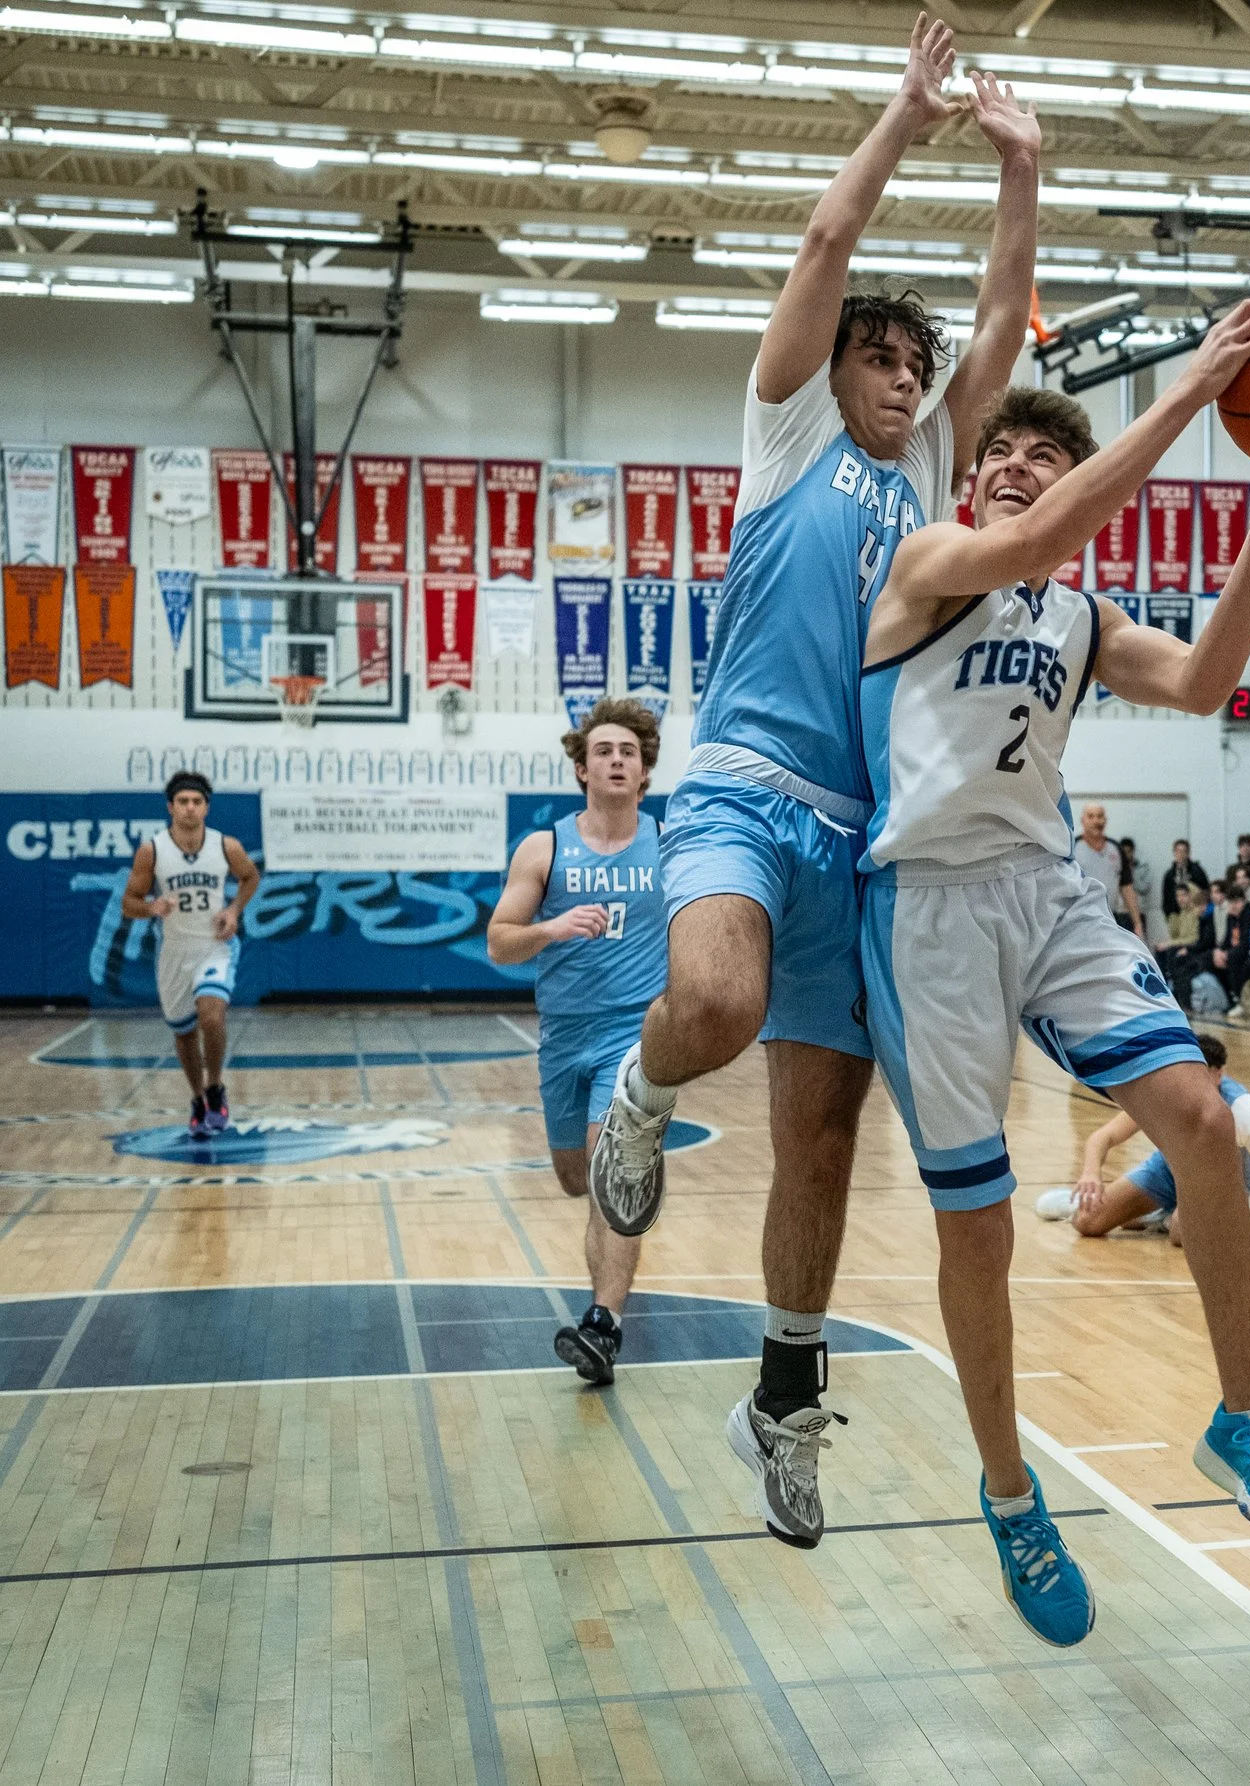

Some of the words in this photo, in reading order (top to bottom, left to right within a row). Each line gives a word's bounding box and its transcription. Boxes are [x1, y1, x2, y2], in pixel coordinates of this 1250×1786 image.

[858, 526, 885, 607] 4
[995, 704, 1030, 774] 2
[413, 807, 500, 820] INVITATIONAL
[293, 821, 379, 834] BASKETBALL
[384, 821, 476, 834] TOURNAMENT
[166, 871, 219, 891] TIGERS
[565, 867, 654, 893] BIALIK
[178, 889, 210, 913] 23
